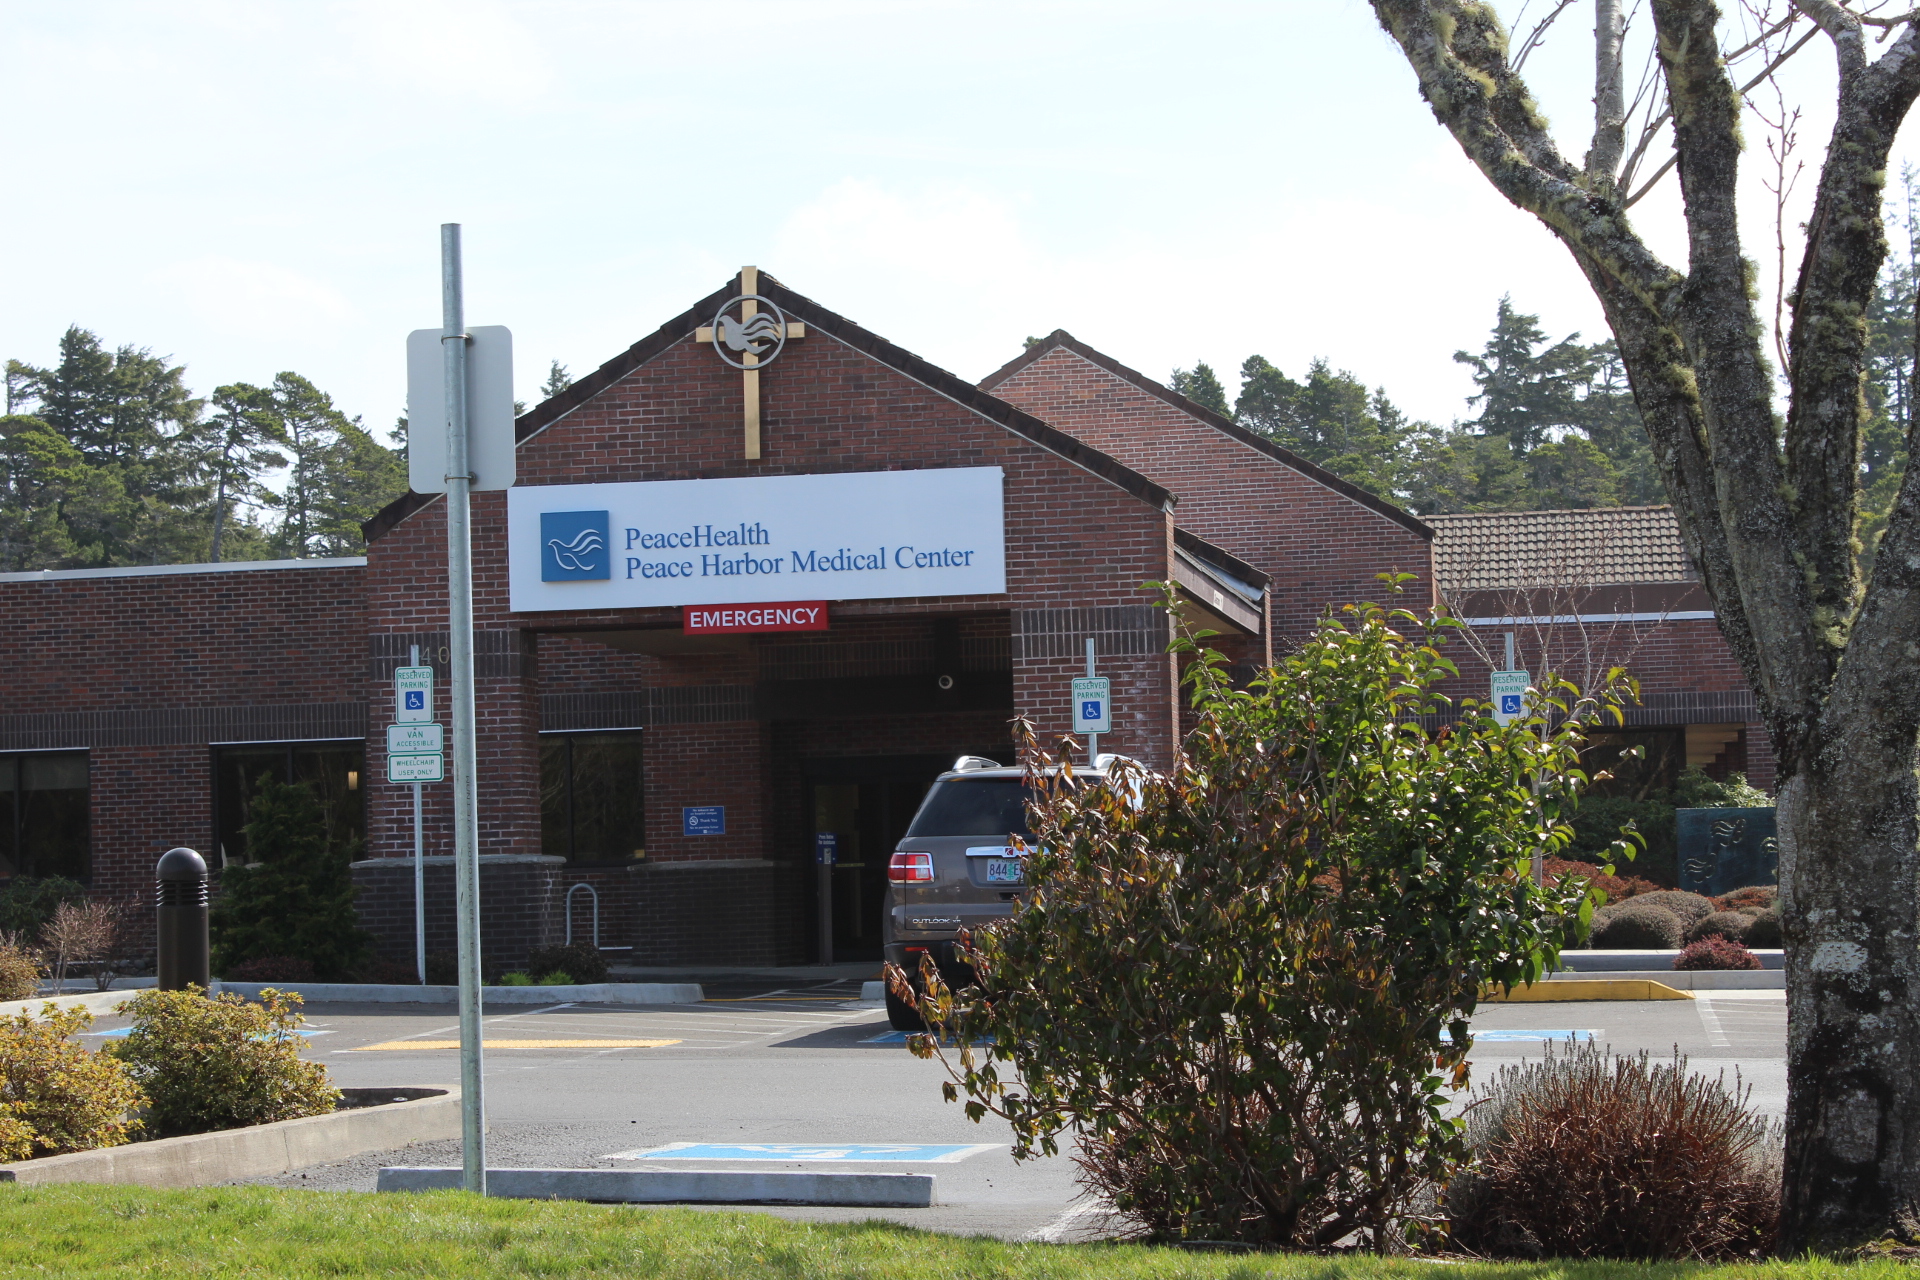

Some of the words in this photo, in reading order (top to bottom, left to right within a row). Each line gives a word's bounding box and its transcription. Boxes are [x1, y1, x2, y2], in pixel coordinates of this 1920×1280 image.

[625, 522, 770, 550] PeaceHealth
[626, 556, 693, 579] Peace
[701, 551, 784, 576] Harbor
[791, 547, 887, 573] Medical
[894, 546, 974, 569] Center
[690, 607, 819, 628] EMERGENCY
[398, 671, 430, 680] RESERVED
[1494, 675, 1527, 683] RESERVED
[401, 681, 428, 689] PARKING
[1075, 681, 1106, 690] RESERVED
[1497, 685, 1525, 693] PARKING
[1077, 691, 1105, 699] PARKING
[989, 863, 1008, 876] 844
